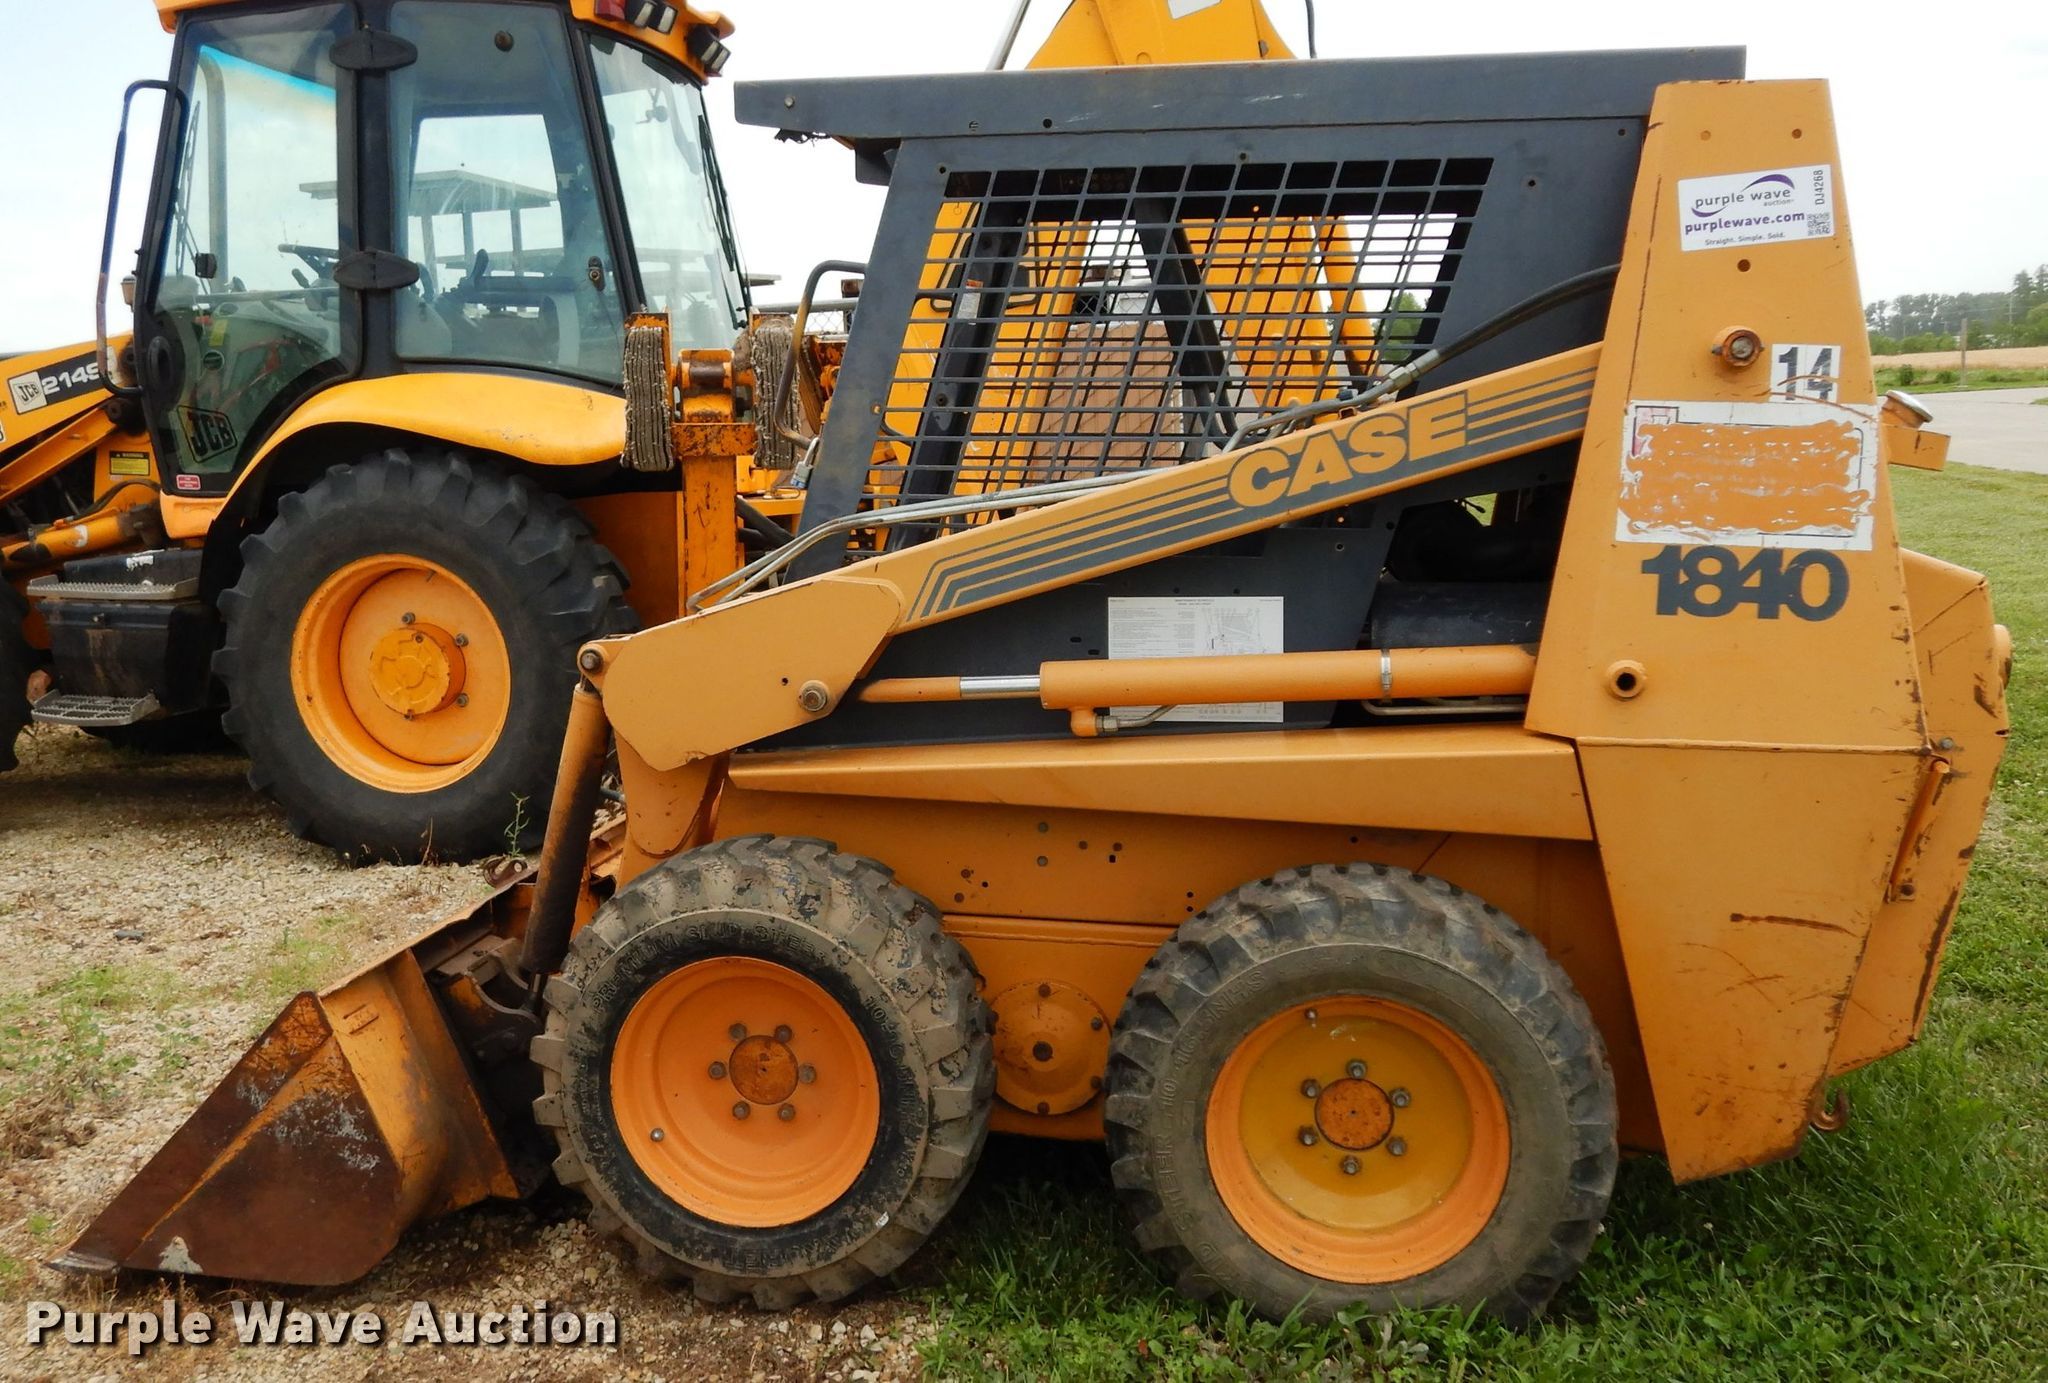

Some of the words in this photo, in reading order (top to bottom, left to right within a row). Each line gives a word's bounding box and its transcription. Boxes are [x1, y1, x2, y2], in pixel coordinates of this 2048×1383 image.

[1695, 192, 1744, 209] purple
[1750, 188, 1791, 201] wave
[1813, 169, 1825, 206] DJ4268
[1685, 212, 1805, 235] purplewave.com
[19, 384, 39, 402] JCB
[1776, 346, 1833, 401] 14
[187, 410, 232, 457] JCB
[1229, 391, 1467, 507] CASE
[1641, 545, 1849, 622] 1840
